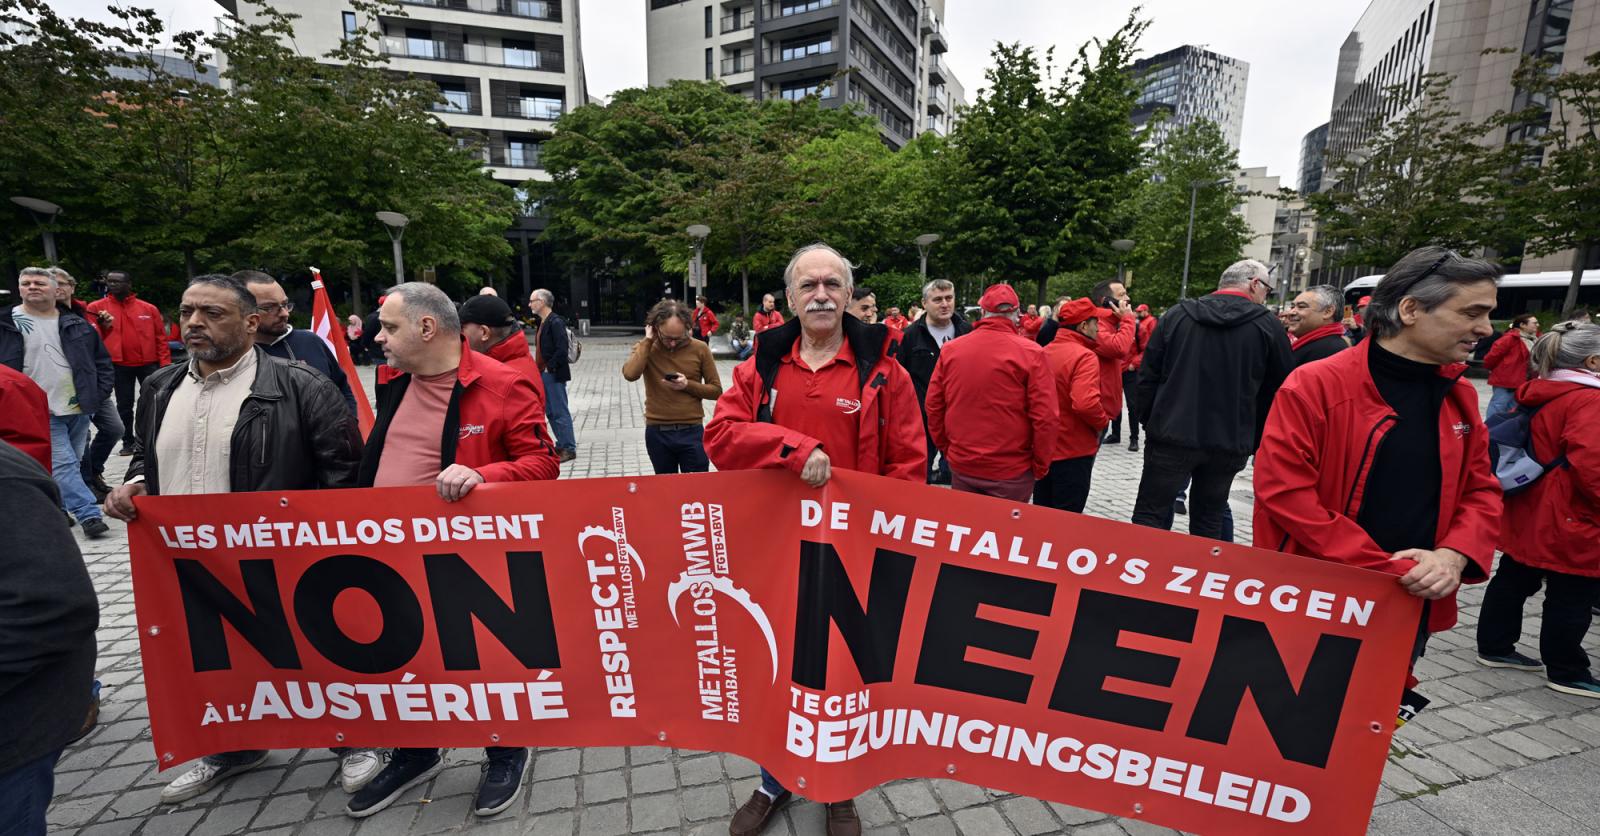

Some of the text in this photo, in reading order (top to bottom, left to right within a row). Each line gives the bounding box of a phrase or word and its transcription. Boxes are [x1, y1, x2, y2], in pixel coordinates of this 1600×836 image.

[158, 513, 544, 549] LES MÉTALLOS DISENT
[612, 507, 639, 629] METALLOS FGTB-ABVV
[709, 505, 728, 573] FGTB-ABVV
[800, 499, 1376, 626] DE METALLO'S ZEGGEN
[173, 551, 562, 674] NON
[586, 553, 637, 718] RESPECT.
[681, 501, 724, 721] METALLOS MWB
[791, 539, 1363, 769] NEEN
[200, 701, 224, 726] À
[723, 645, 740, 723] BRABANT
[790, 686, 870, 717] TEGEN
[785, 708, 1312, 823] BEZUINIGINGSBELEID
